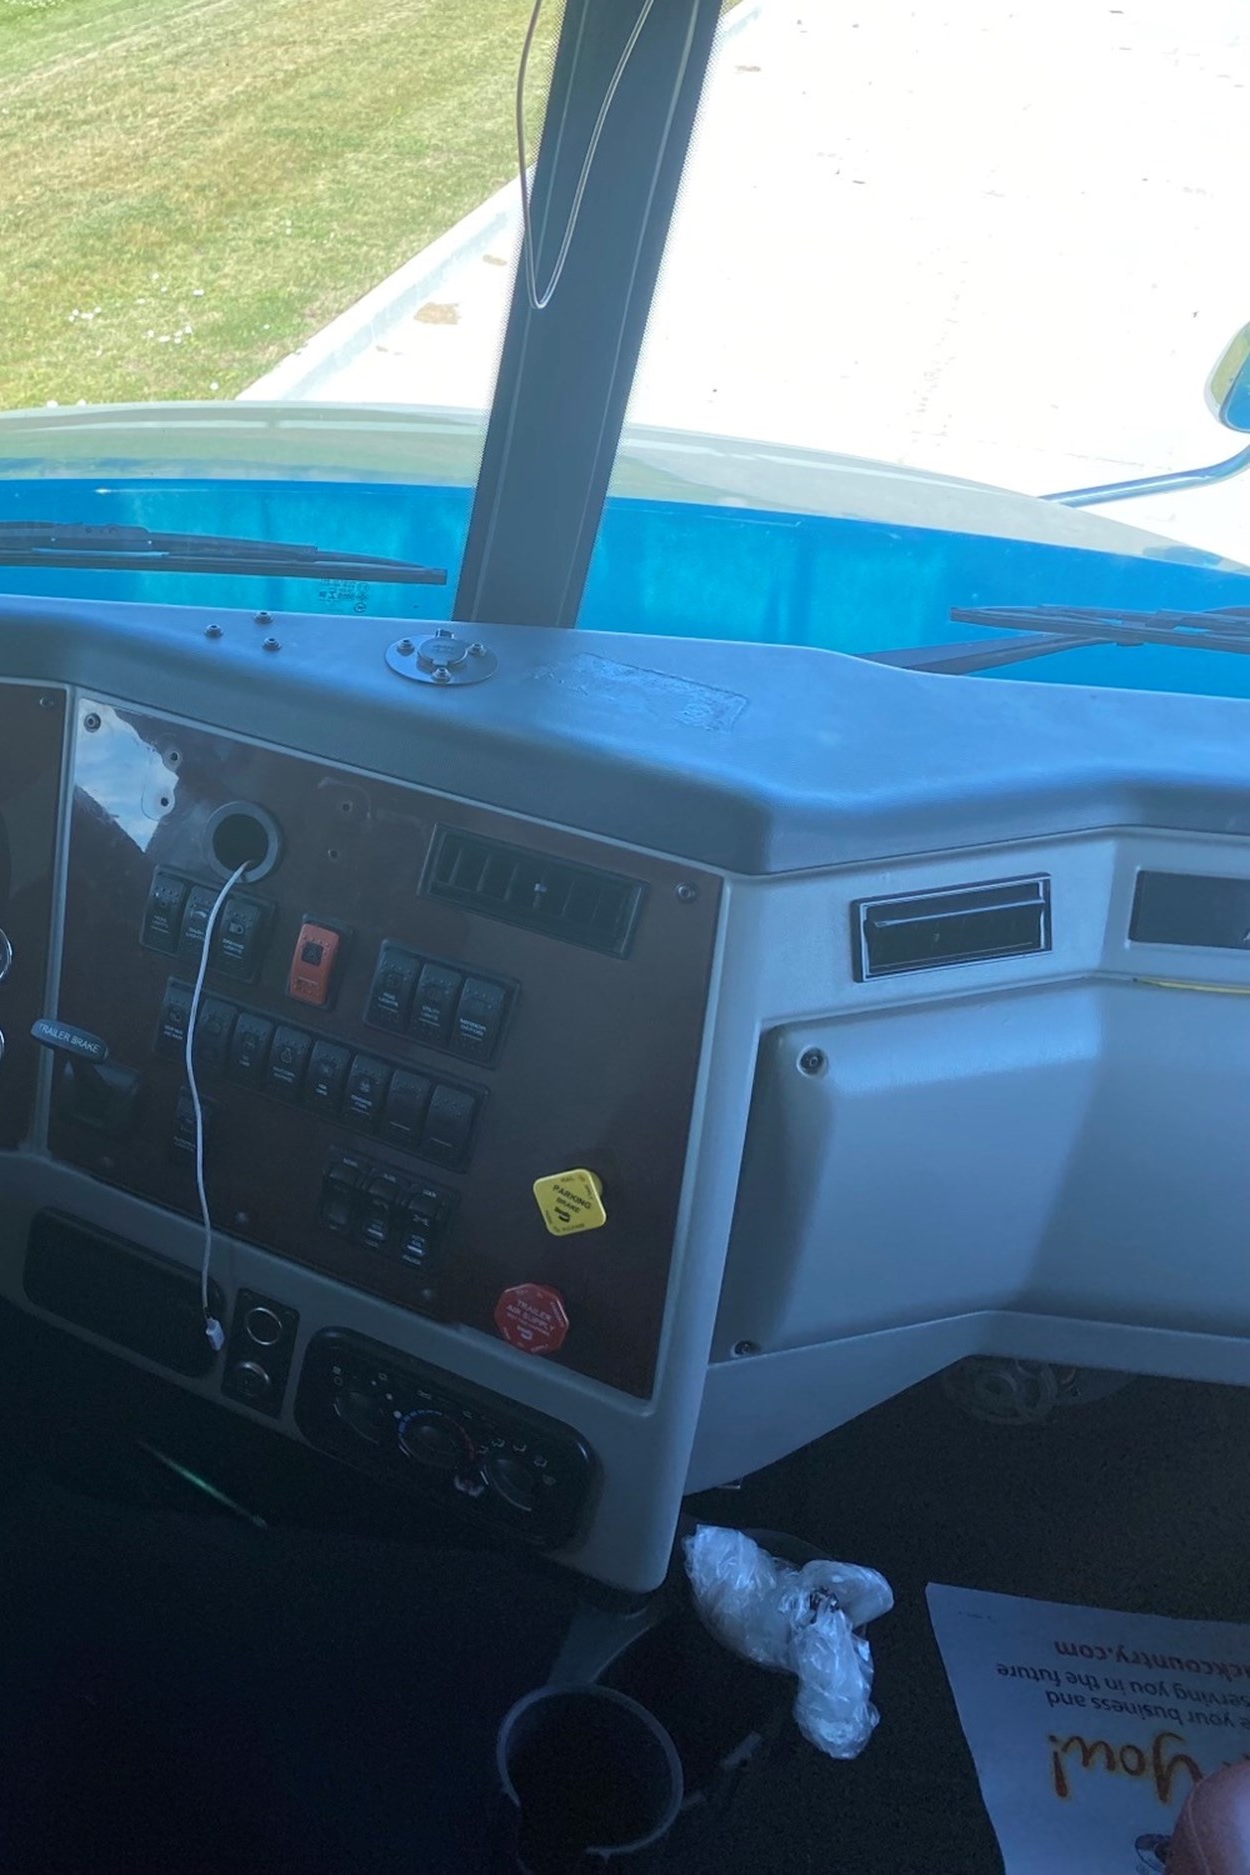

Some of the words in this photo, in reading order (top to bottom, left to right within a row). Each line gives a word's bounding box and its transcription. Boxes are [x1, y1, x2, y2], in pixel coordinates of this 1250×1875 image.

[38, 1022, 71, 1042] TRAILER
[70, 1035, 101, 1054] BRAKE
[552, 1184, 592, 1210] PARKING
[556, 1196, 581, 1214] BRAKE
[996, 1662, 1060, 1685] future
[1066, 1672, 1102, 1691] the
[1105, 1679, 1129, 1693] in
[1131, 1679, 1173, 1698] you
[1045, 1690, 1088, 1711] and
[1090, 1696, 1183, 1726] business
[1188, 1711, 1235, 1728] your
